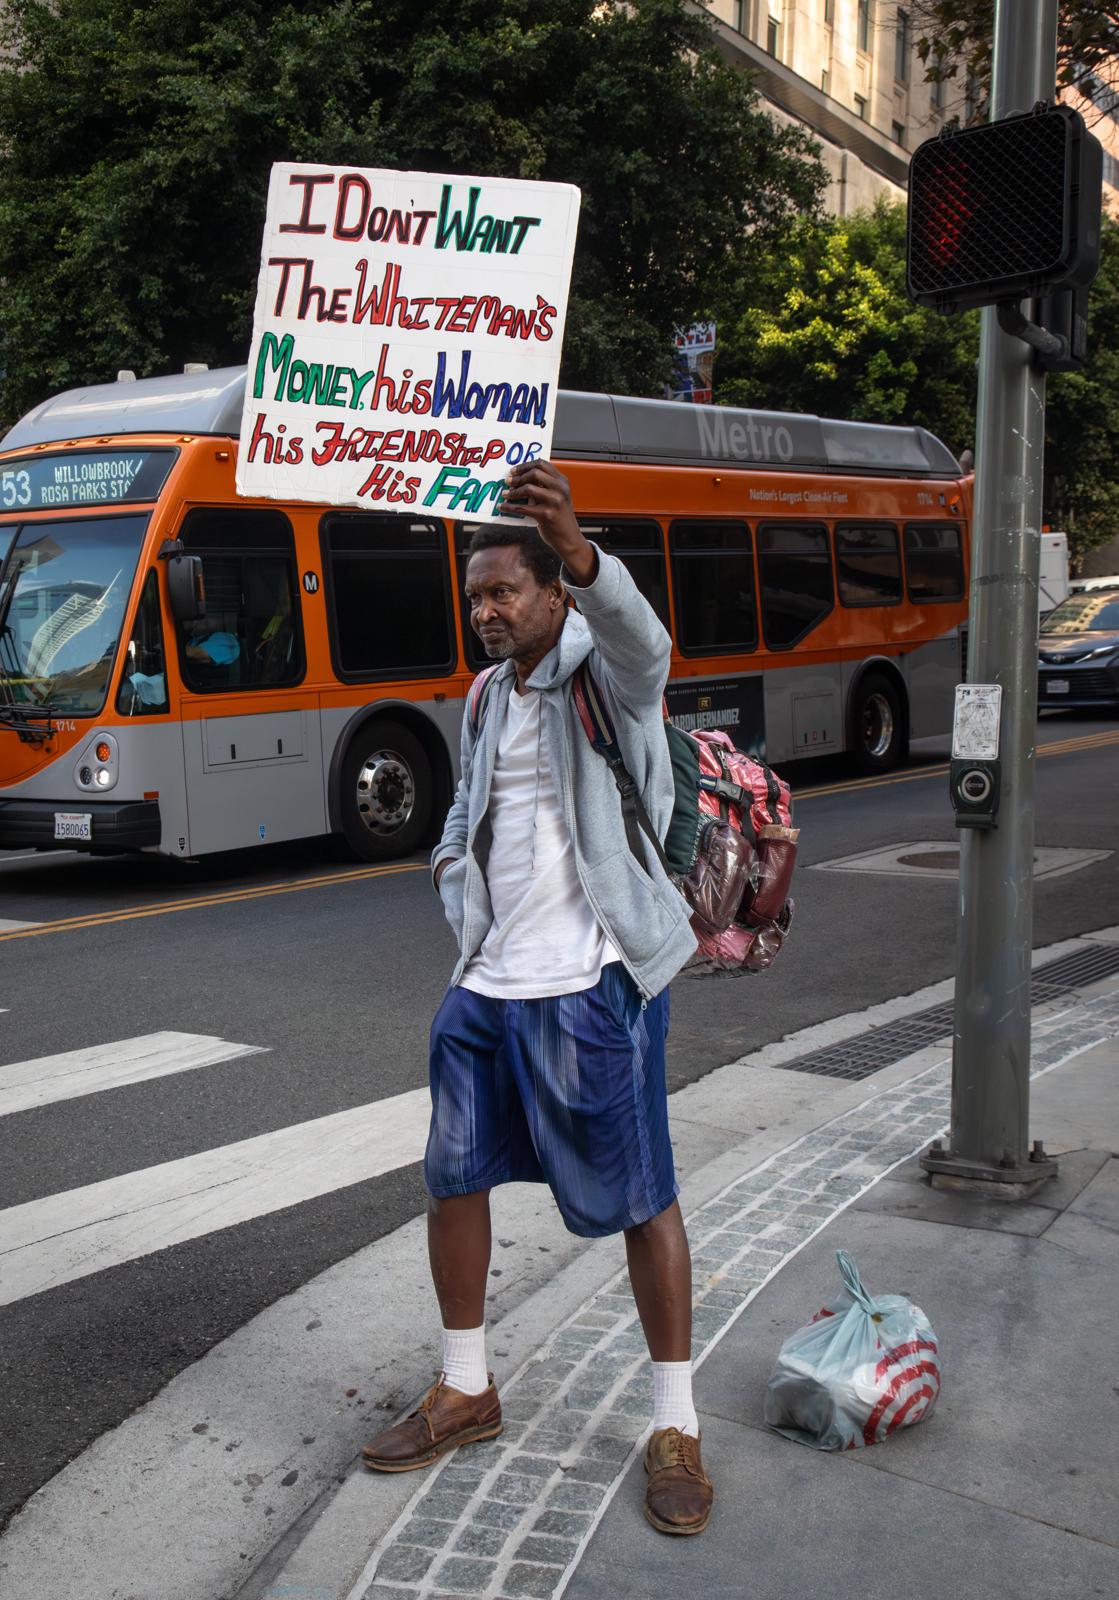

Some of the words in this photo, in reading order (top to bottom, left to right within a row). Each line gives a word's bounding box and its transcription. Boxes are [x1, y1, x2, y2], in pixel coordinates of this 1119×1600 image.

[279, 173, 335, 235] I
[434, 184, 541, 254] WANT
[370, 343, 433, 415] his
[247, 413, 303, 465] his
[506, 442, 543, 467] OR
[695, 406, 794, 462] Metro
[2, 470, 32, 506] 53
[41, 485, 70, 503] ROSA
[72, 482, 107, 501] PARKS
[358, 463, 422, 504] His
[422, 466, 510, 515] FAM
[305, 574, 317, 591] M
[56, 720, 76, 732] 1714
[697, 708, 740, 728] HERNANDEZ
[56, 823, 89, 836] 1580065
